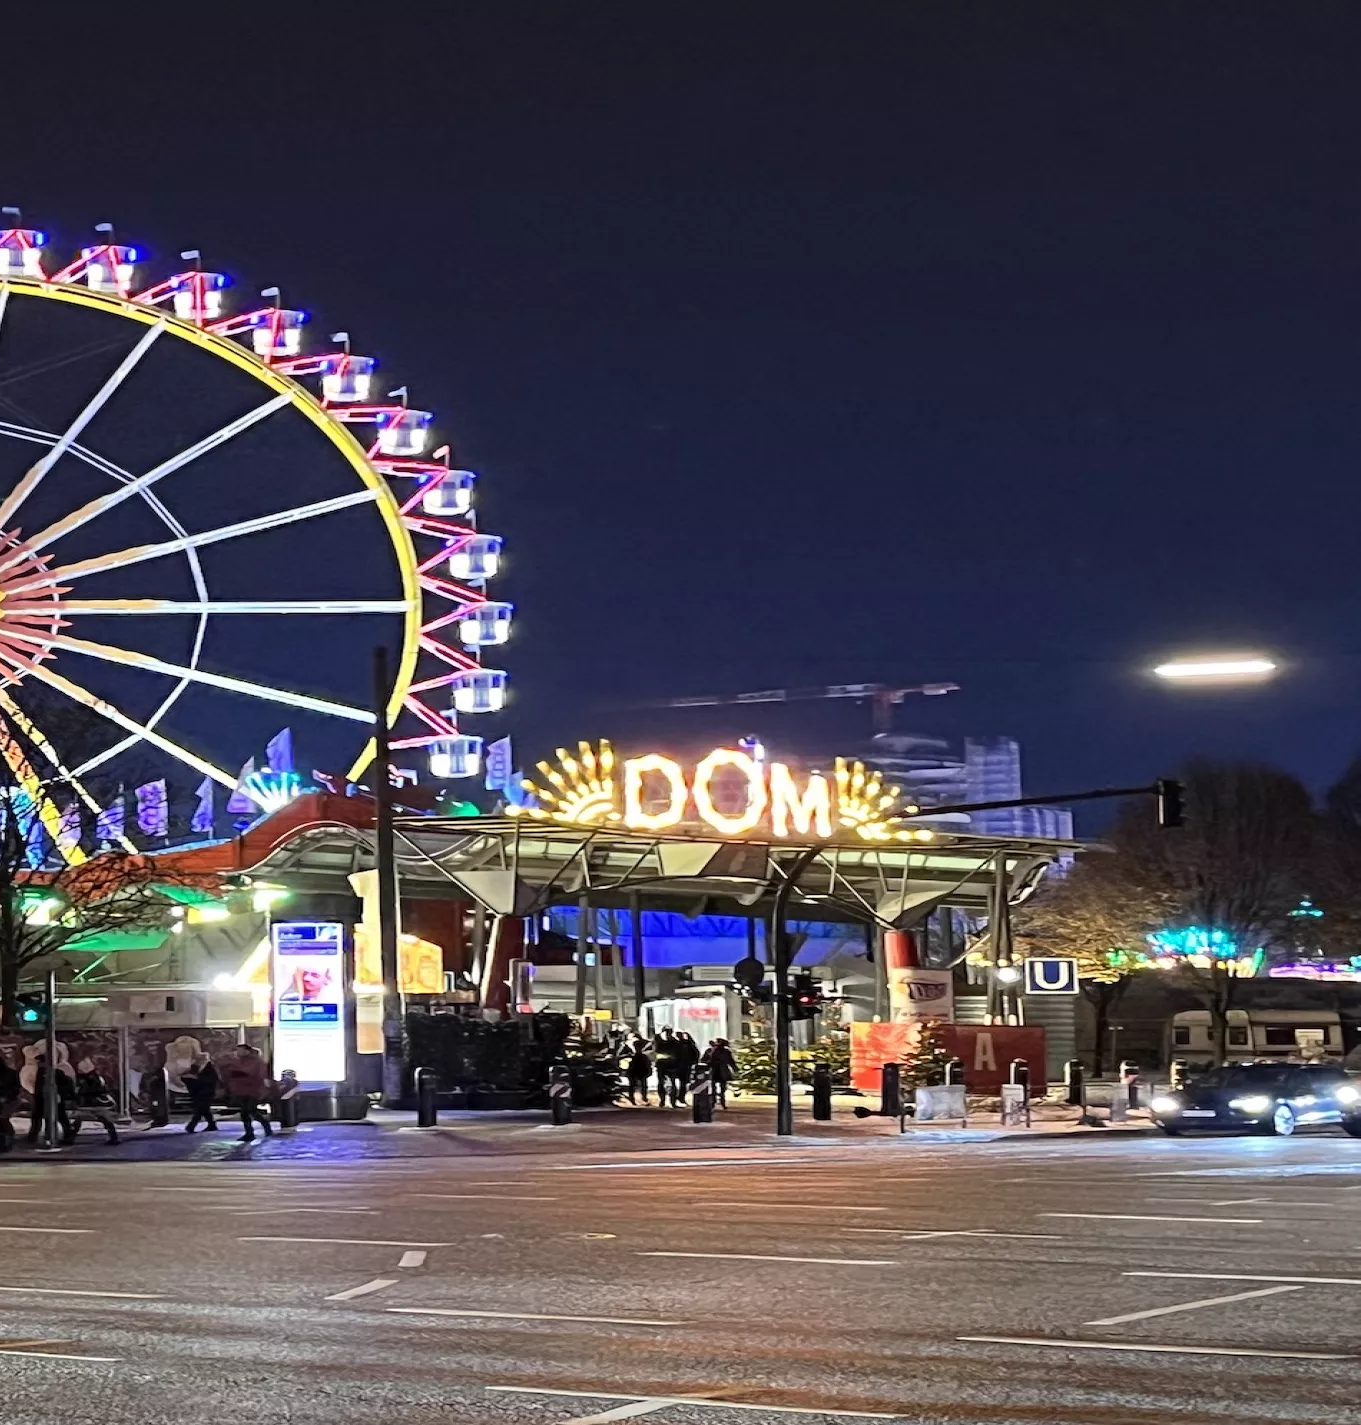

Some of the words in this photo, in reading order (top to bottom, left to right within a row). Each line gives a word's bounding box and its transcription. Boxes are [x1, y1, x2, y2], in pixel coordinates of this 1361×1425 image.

[624, 748, 831, 838] DOM
[1034, 961, 1070, 990] U
[973, 1032, 997, 1072] A
